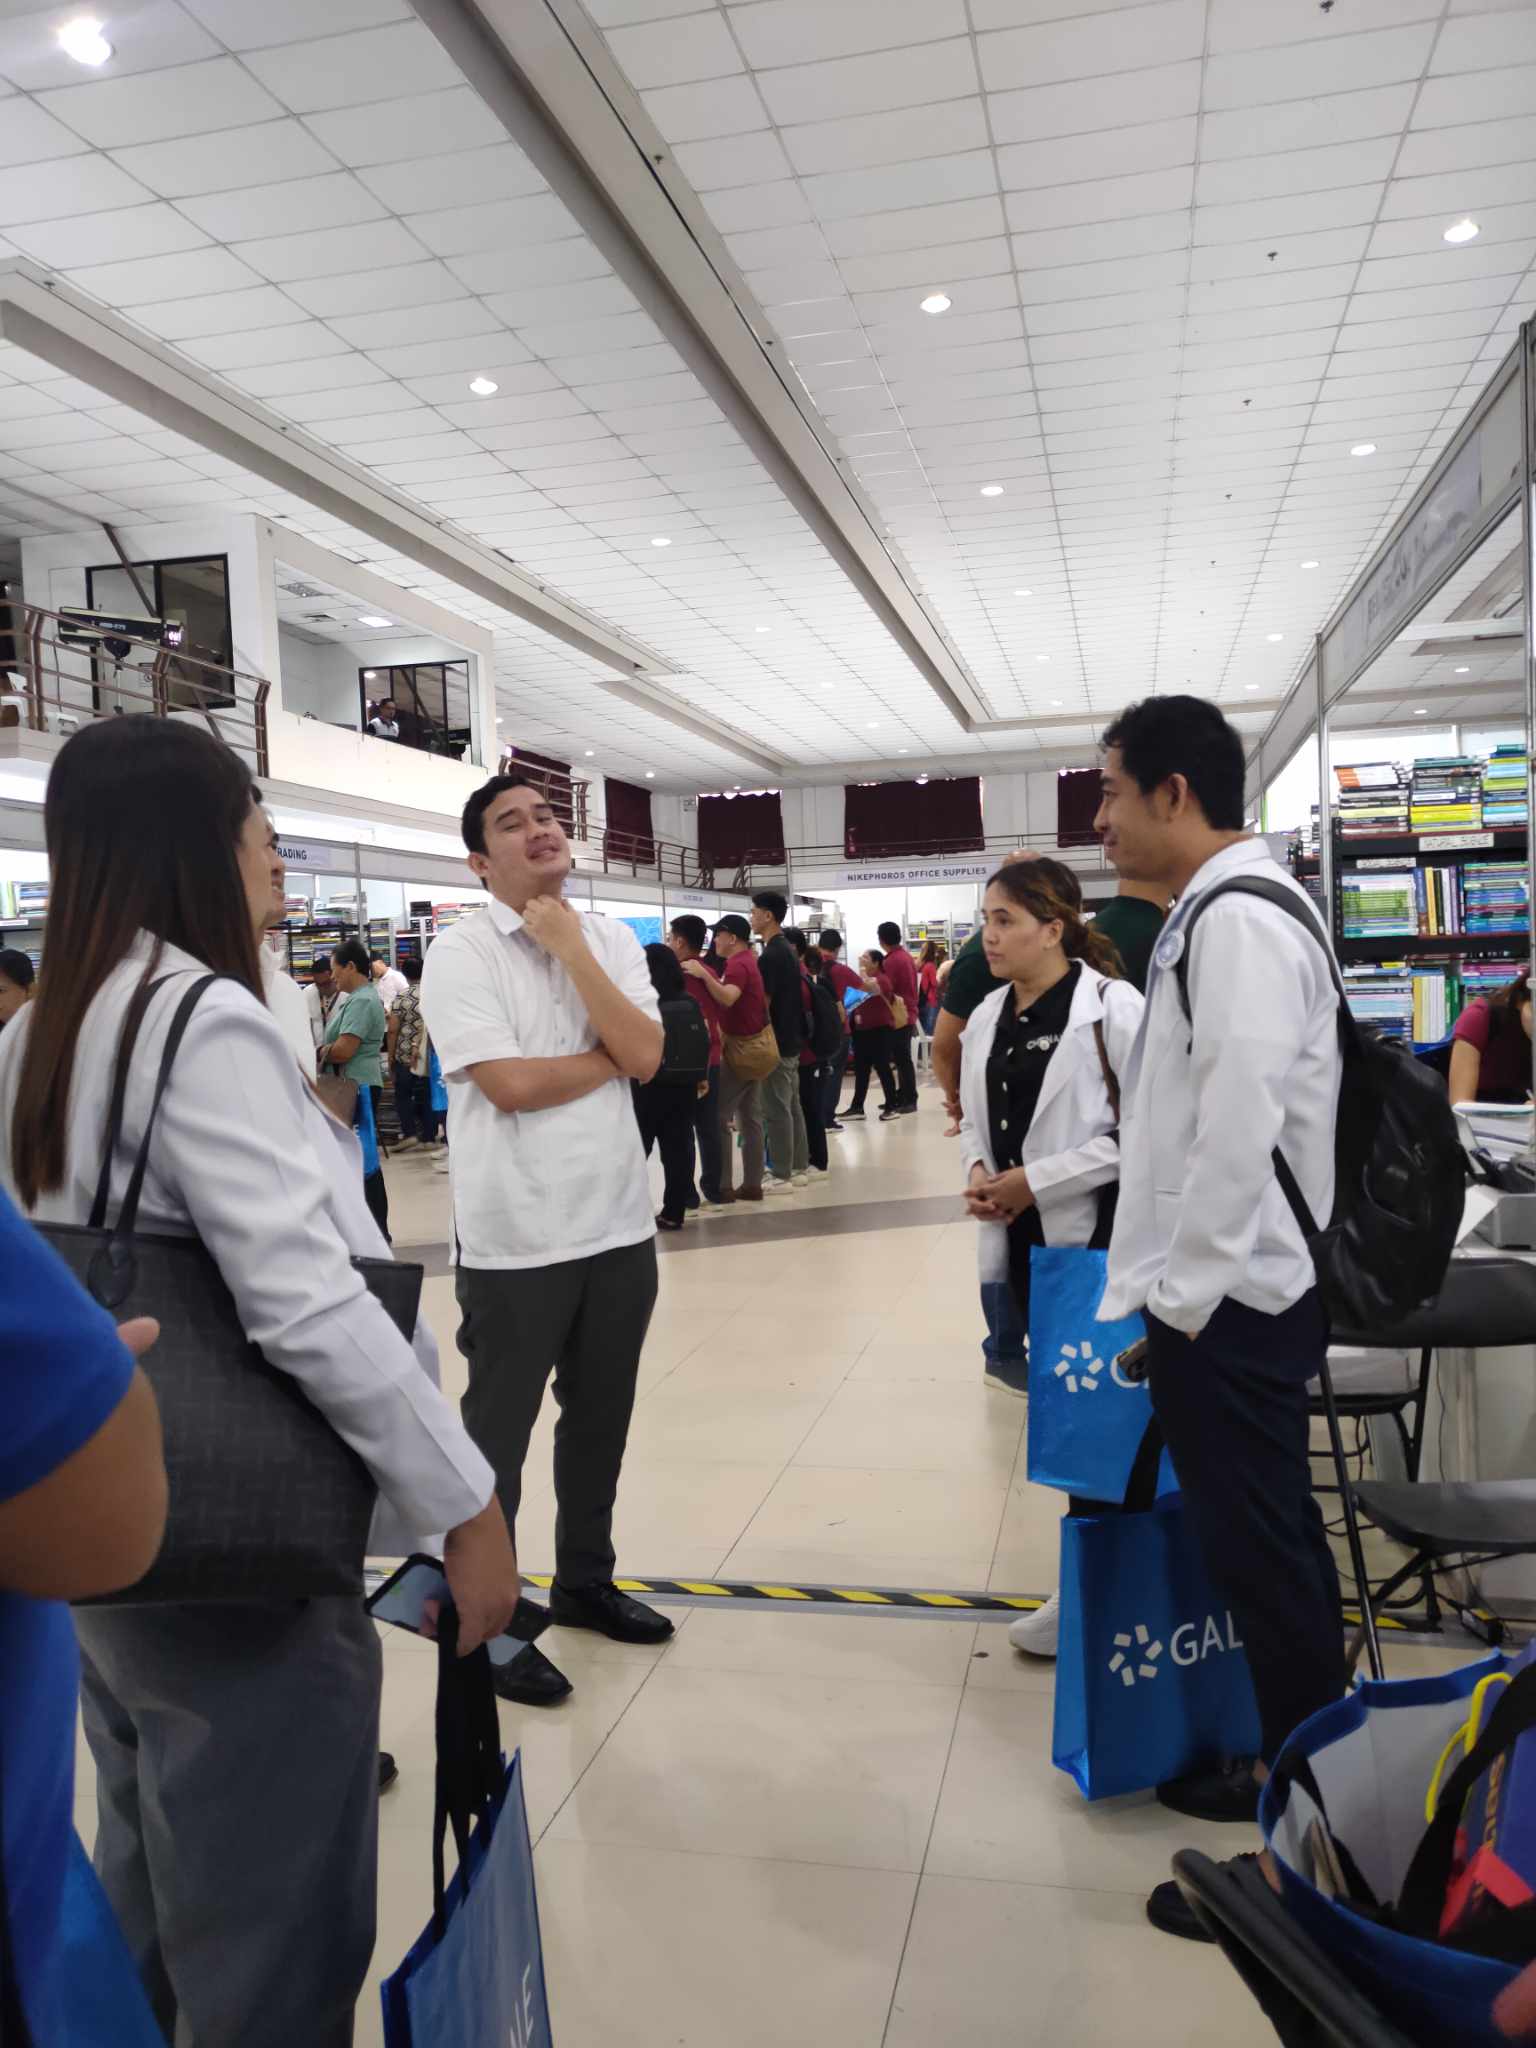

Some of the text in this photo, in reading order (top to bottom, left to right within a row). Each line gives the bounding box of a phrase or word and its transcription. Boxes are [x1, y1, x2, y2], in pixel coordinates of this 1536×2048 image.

[277, 847, 307, 860] RADING
[848, 867, 987, 882] NIKEPHOROS OFFICE SUPPLIES
[1170, 1610, 1244, 1666] GAL
